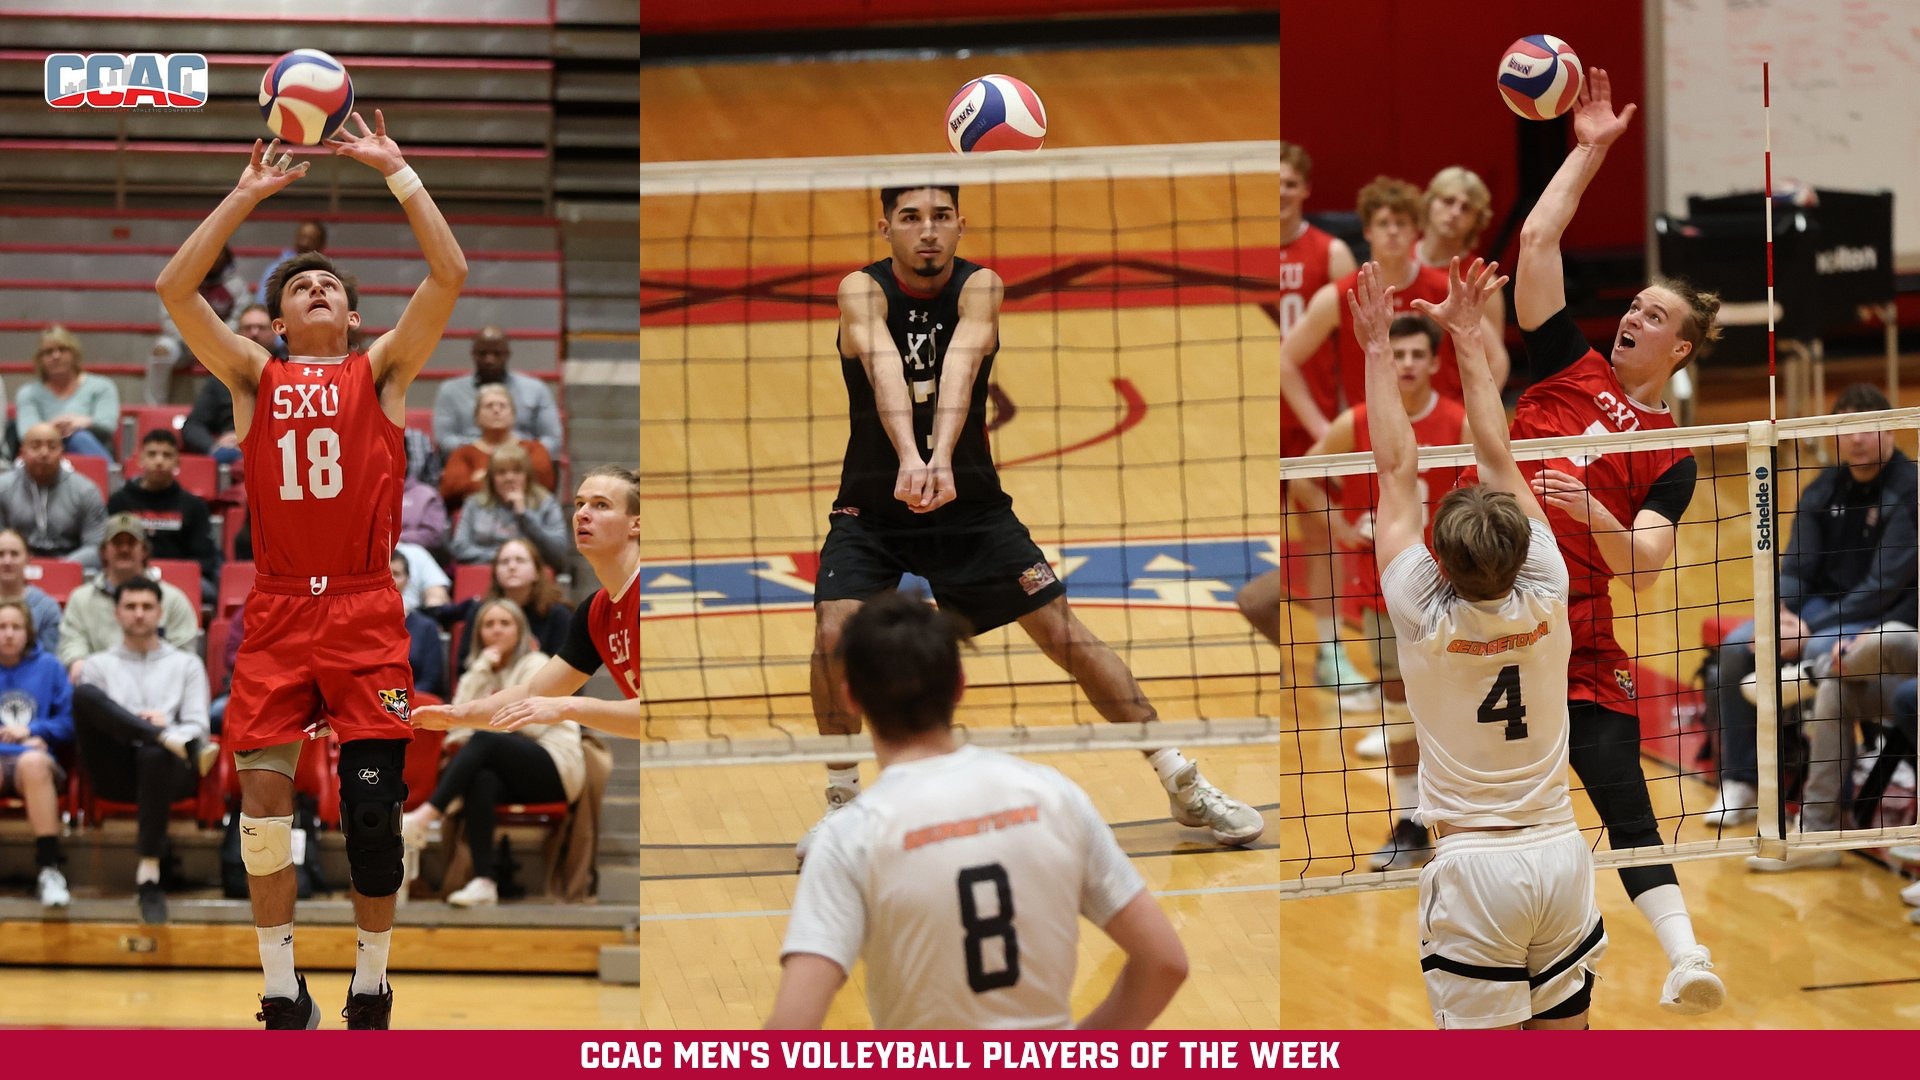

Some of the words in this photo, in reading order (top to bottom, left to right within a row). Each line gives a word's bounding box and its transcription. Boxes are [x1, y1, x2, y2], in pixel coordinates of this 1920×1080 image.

[1280, 263, 1304, 290] XU
[273, 384, 339, 419] SXU
[277, 427, 344, 501] 18
[1756, 482, 1771, 551] Schelde
[1477, 664, 1528, 741] 4
[957, 863, 1021, 993] 8
